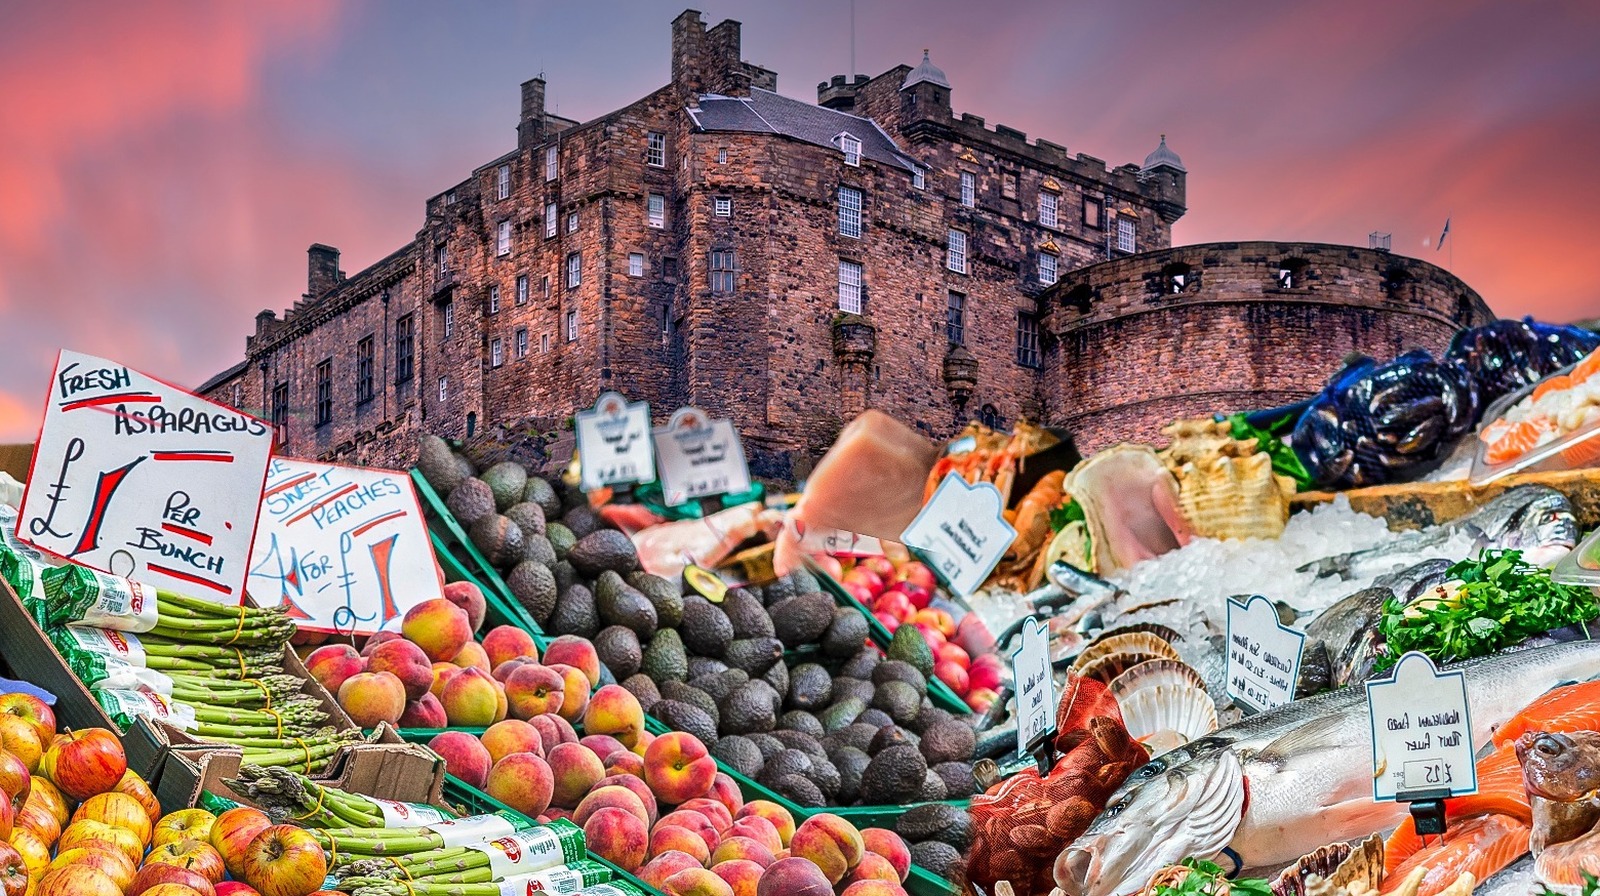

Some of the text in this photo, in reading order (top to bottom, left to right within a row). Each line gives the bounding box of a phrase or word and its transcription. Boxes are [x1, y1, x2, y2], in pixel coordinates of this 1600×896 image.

[58, 363, 130, 398] FRESH
[114, 404, 268, 436] ASPARAGUS
[162, 490, 201, 527] PER
[266, 467, 335, 514] SWEET
[310, 477, 401, 530] PEACHES
[126, 527, 225, 575] BUNCH
[300, 550, 333, 582] FOR
